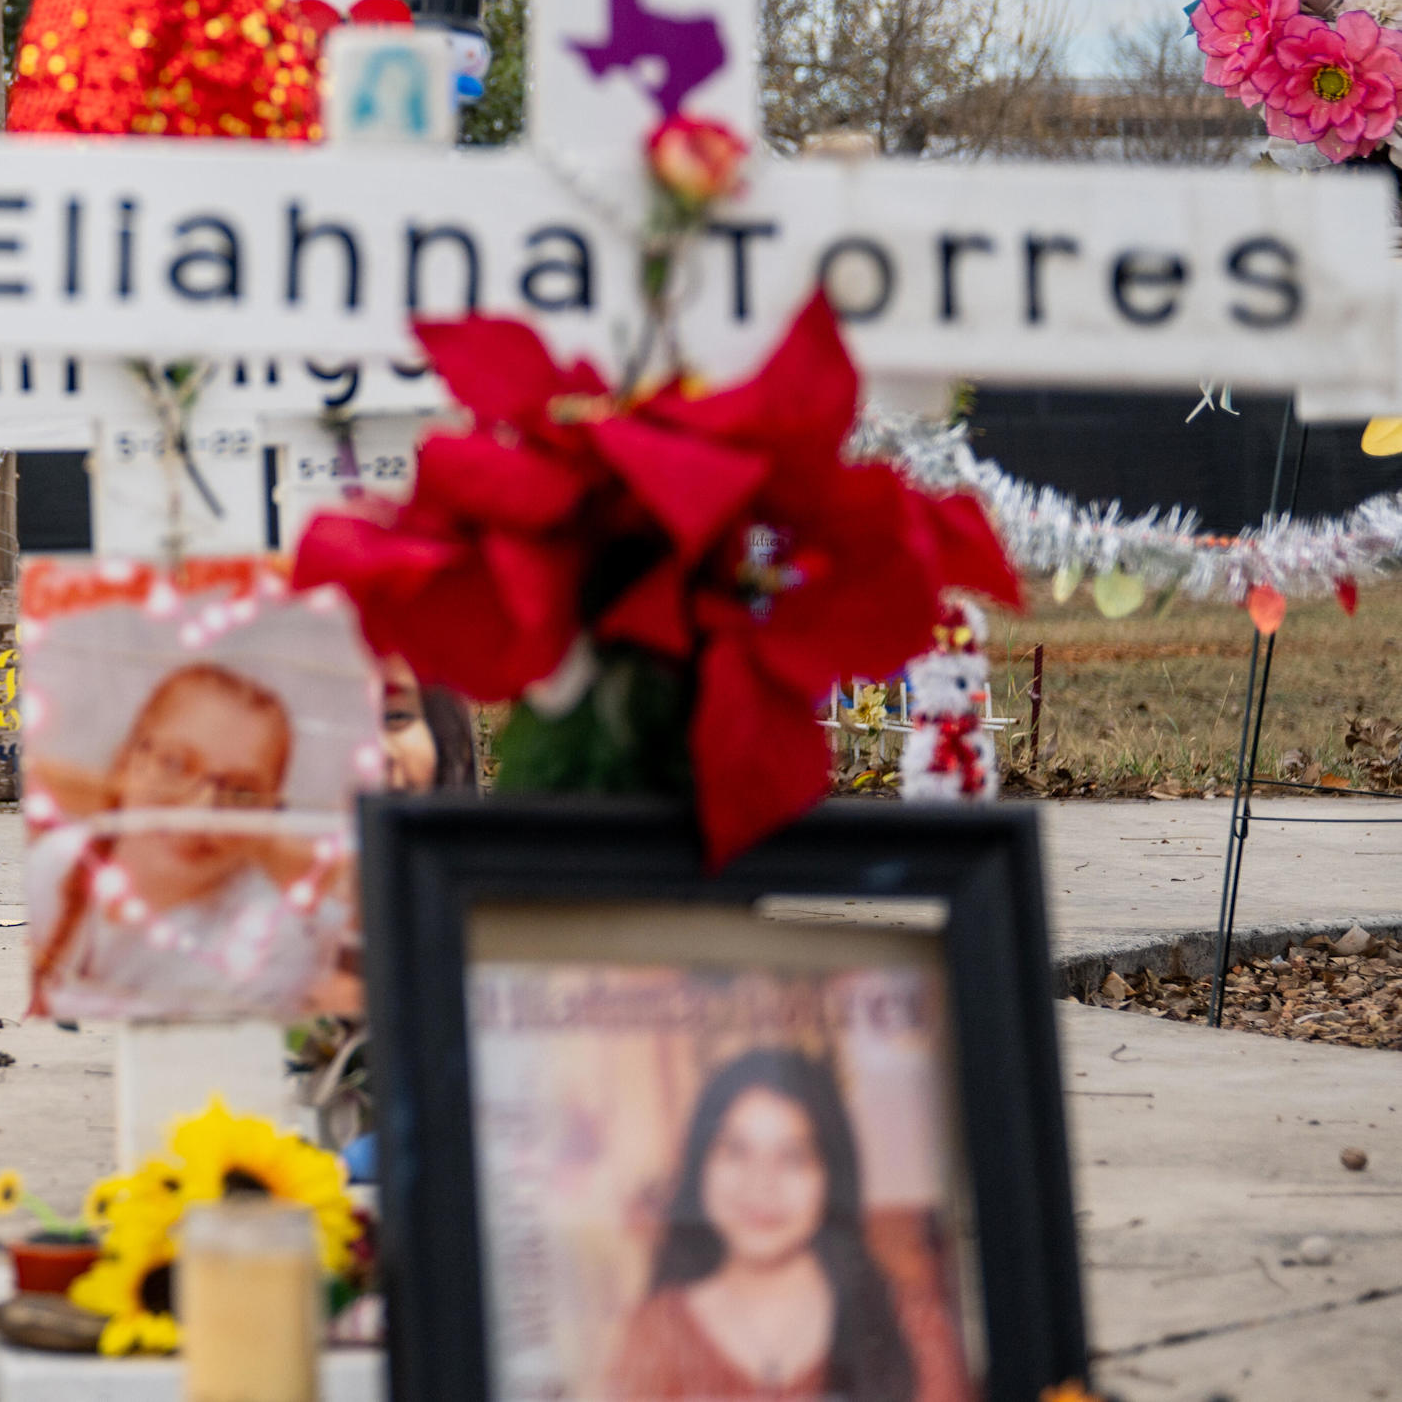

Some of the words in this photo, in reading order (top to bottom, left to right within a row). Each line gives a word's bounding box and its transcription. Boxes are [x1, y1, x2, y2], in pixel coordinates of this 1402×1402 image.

[709, 221, 1305, 328] Torres
[116, 430, 252, 460] 5-2-22
[298, 455, 409, 481] 5-2-22
